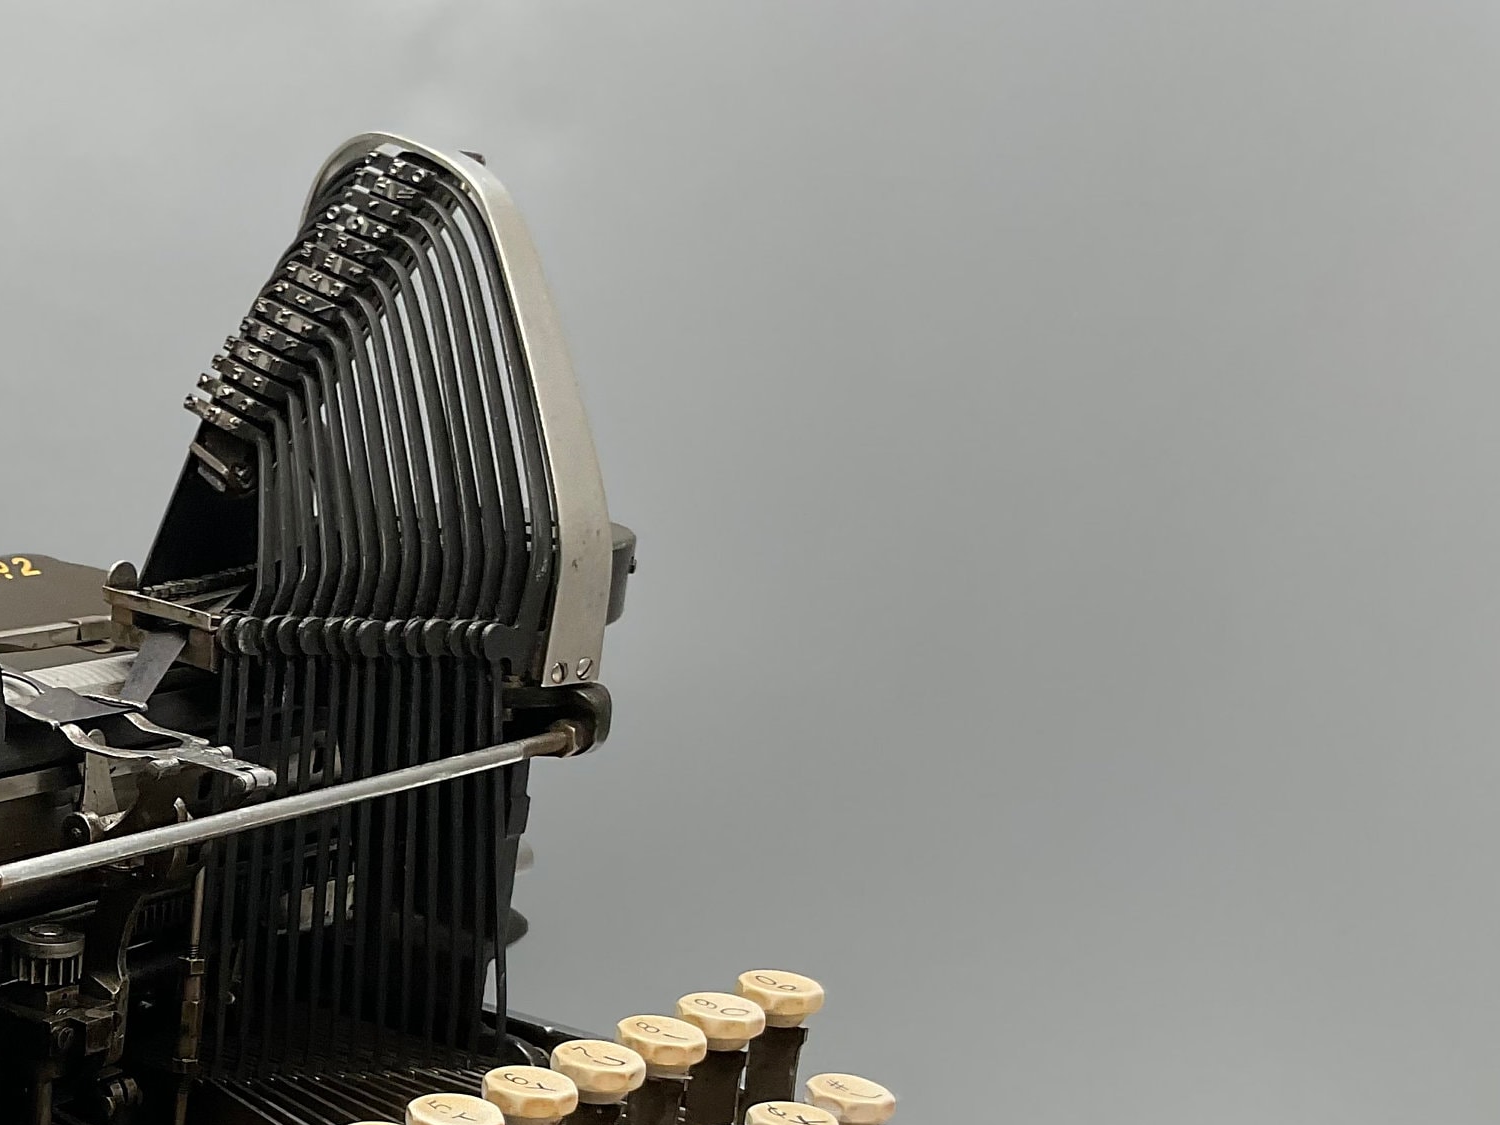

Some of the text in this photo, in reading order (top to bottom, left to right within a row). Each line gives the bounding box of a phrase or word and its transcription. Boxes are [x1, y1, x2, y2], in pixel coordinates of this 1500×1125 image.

[11, 557, 42, 577] 2
[636, 1021, 660, 1034] 8
[593, 1056, 625, 1066] U
[504, 1073, 529, 1086] 6
[525, 1083, 557, 1092] Y
[427, 1100, 453, 1114] 5
[452, 1112, 477, 1122] T
[789, 1115, 828, 1125] K
